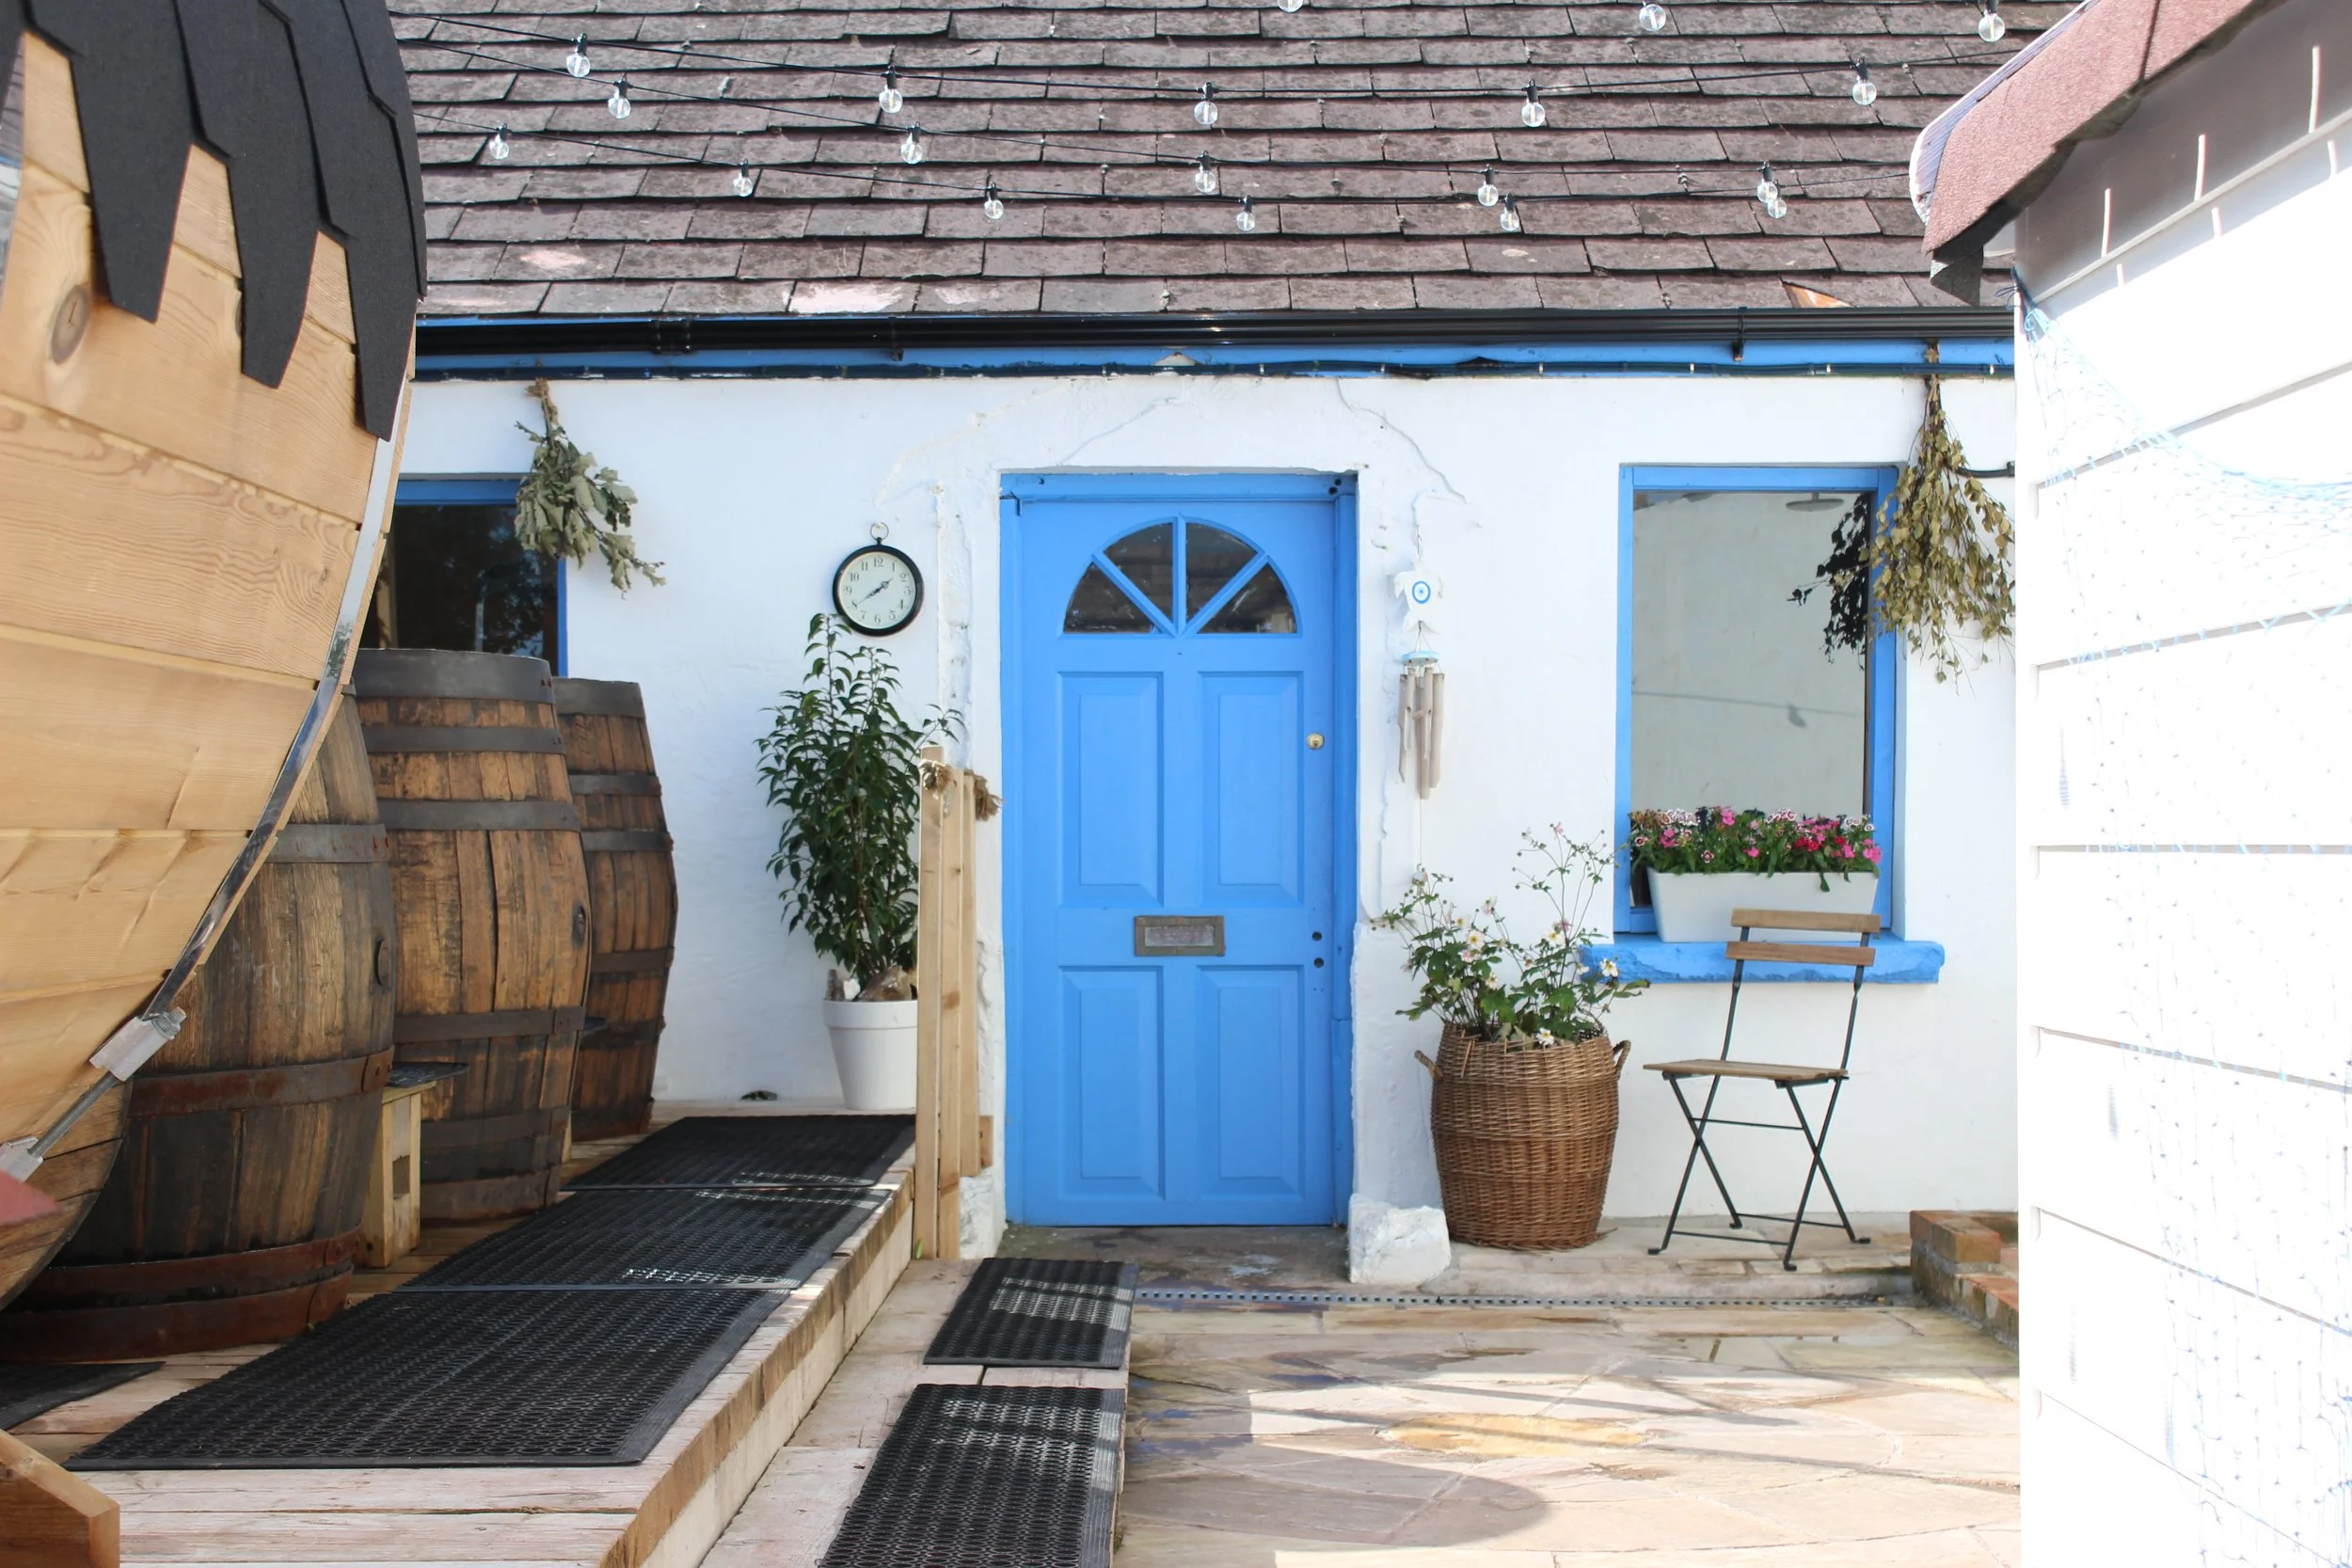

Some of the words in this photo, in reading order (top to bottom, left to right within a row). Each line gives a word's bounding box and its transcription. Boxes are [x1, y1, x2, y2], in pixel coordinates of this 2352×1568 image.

[861, 562, 868, 572] 11
[873, 558, 884, 567] 12
[891, 562, 896, 572] 1
[850, 574, 860, 582] 10
[899, 574, 907, 582] 2
[845, 586, 852, 595] 9
[903, 586, 912, 595] 3
[851, 600, 858, 610] 8
[898, 599, 904, 610] 4
[860, 610, 866, 620] 7
[874, 615, 882, 625] 6
[888, 610, 896, 621] 5
